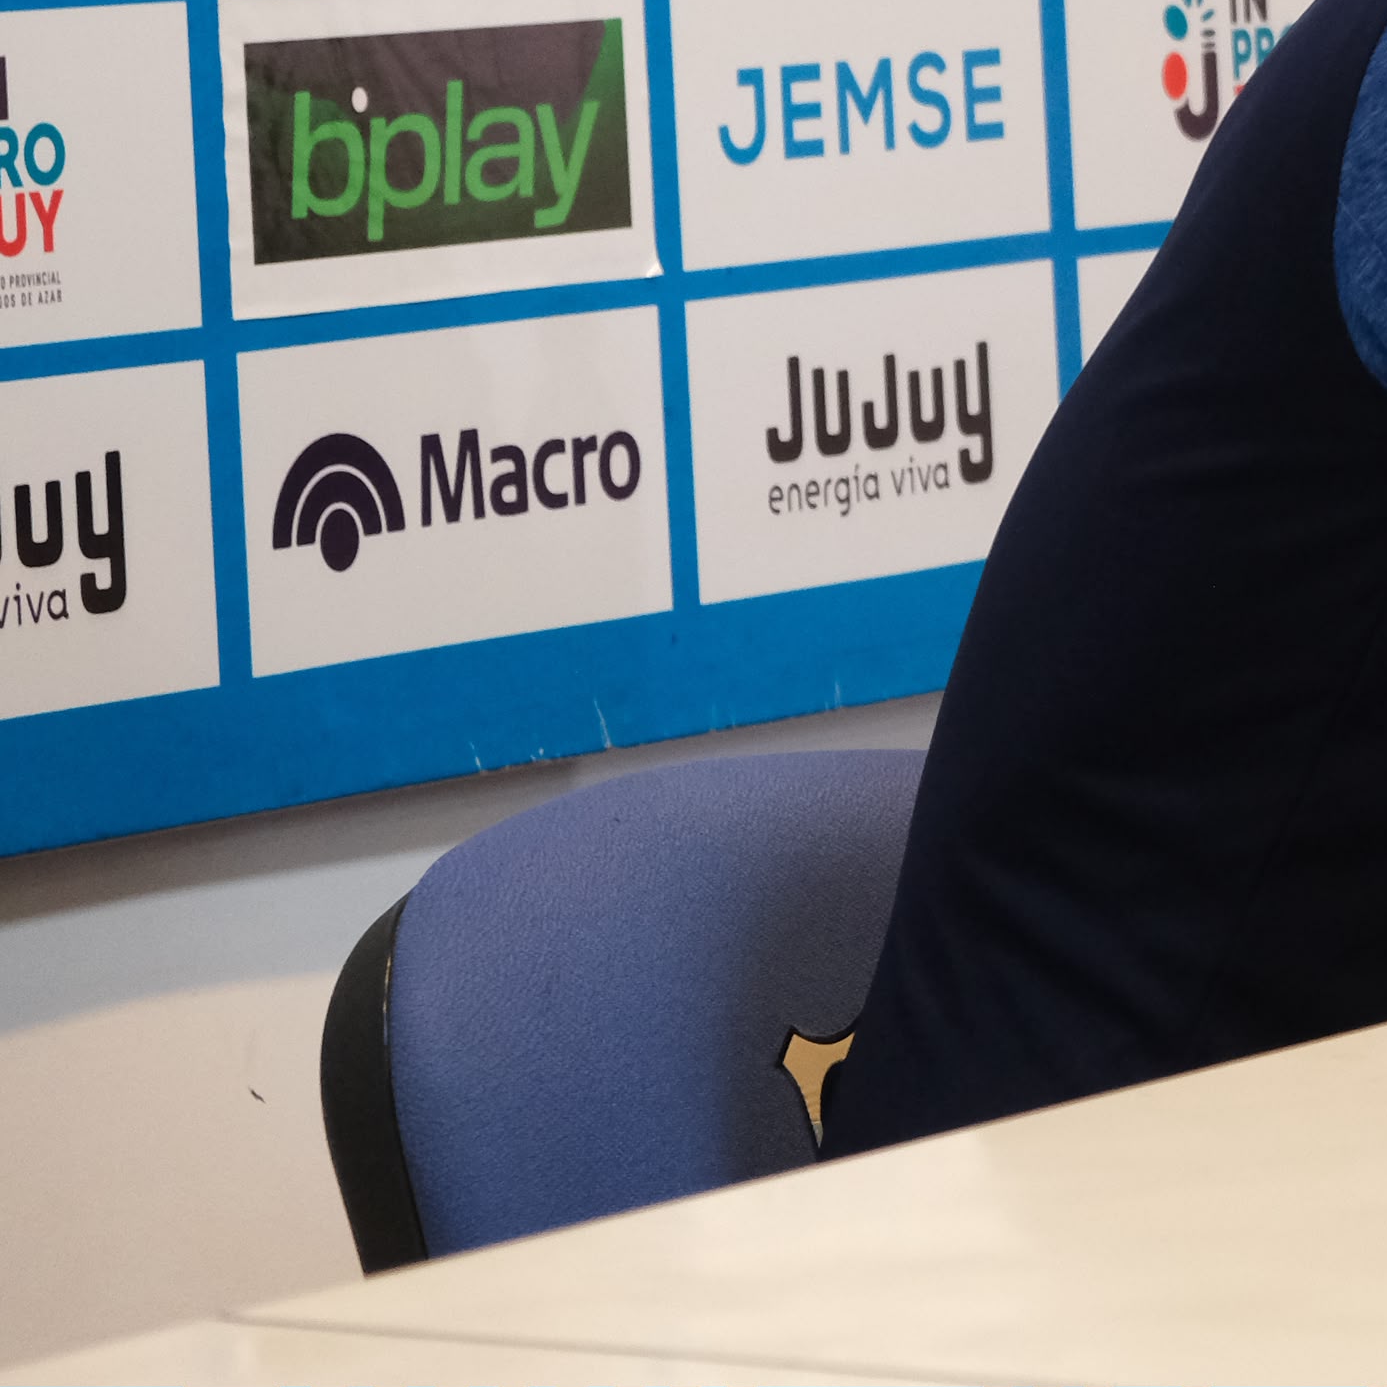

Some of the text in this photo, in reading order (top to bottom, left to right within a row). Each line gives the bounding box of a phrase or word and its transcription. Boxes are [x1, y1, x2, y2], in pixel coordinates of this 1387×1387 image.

[1231, 24, 1294, 80] PR
[717, 47, 1005, 166] JEMSE
[291, 79, 601, 242] bplay
[420, 428, 641, 528] Macro
[767, 454, 951, 517] energía viva
